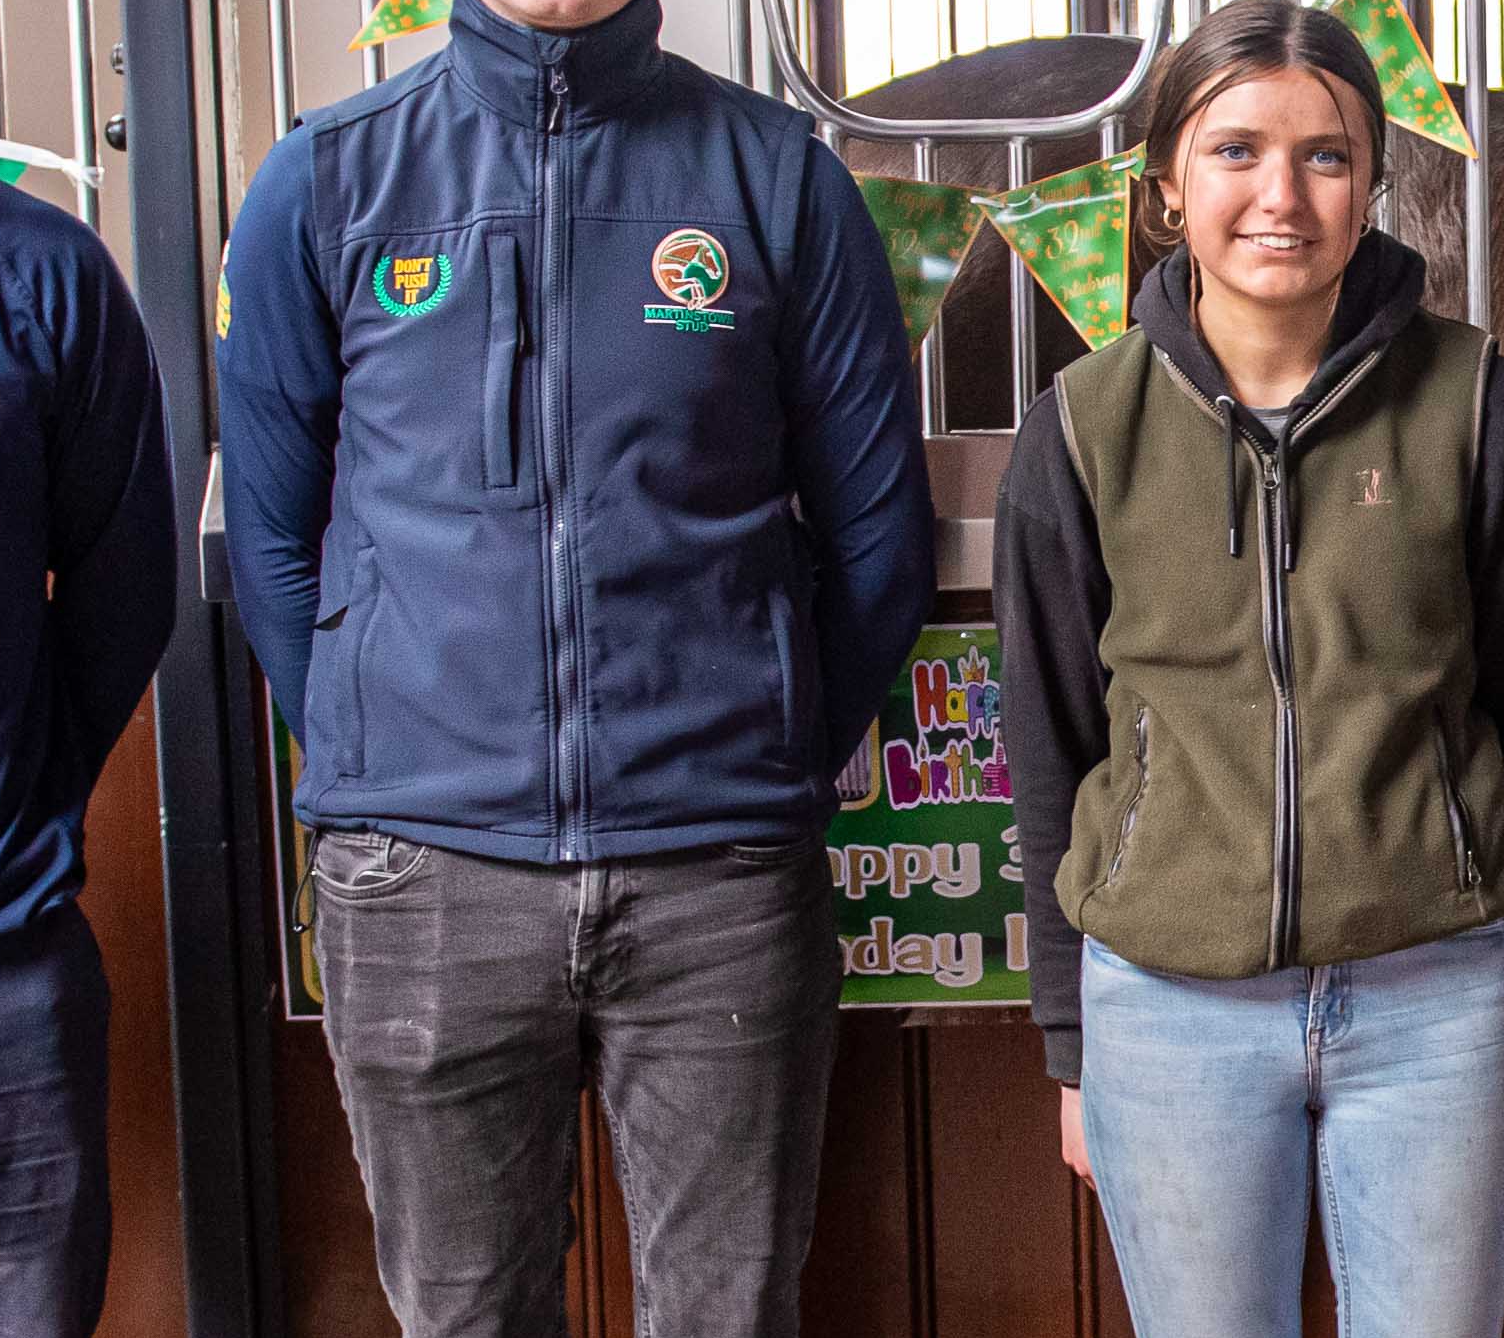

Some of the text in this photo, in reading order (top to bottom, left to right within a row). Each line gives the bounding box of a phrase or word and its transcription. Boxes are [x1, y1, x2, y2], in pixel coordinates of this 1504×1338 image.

[393, 257, 433, 274] DON'T
[395, 273, 428, 289] PUSH
[405, 289, 419, 304] IT
[645, 307, 735, 324] MARTINSTOWN
[676, 321, 709, 332] STUD
[912, 659, 1000, 740] Happ
[840, 916, 984, 987] day
